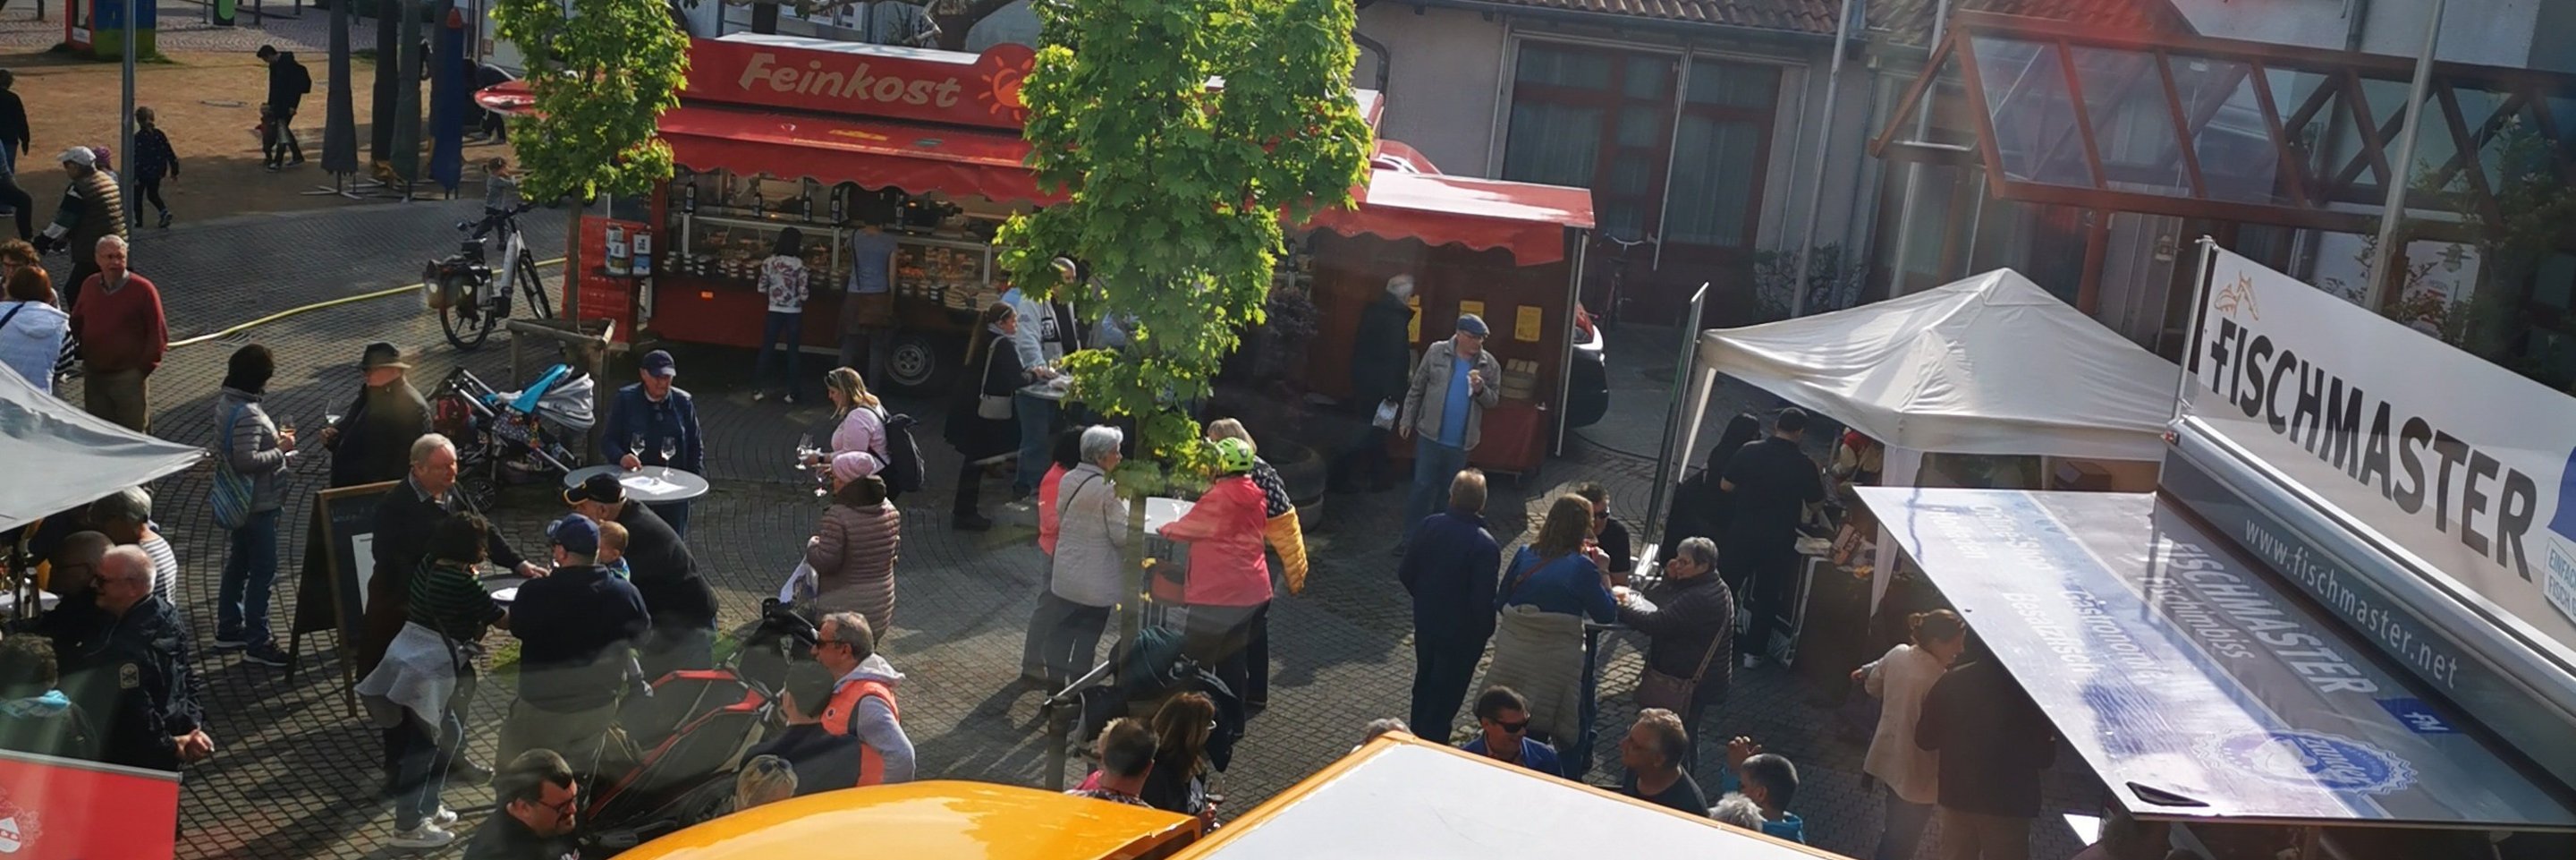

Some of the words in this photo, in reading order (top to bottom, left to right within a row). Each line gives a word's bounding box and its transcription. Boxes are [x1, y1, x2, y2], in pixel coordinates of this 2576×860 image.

[738, 53, 962, 107] Feinkost
[2211, 317, 2538, 583] FISCHMASTER
[2137, 575, 2255, 659] Fischimbiss
[2150, 541, 2379, 694] FISCHMASTER
[2246, 519, 2457, 689] www.fischmaster.net
